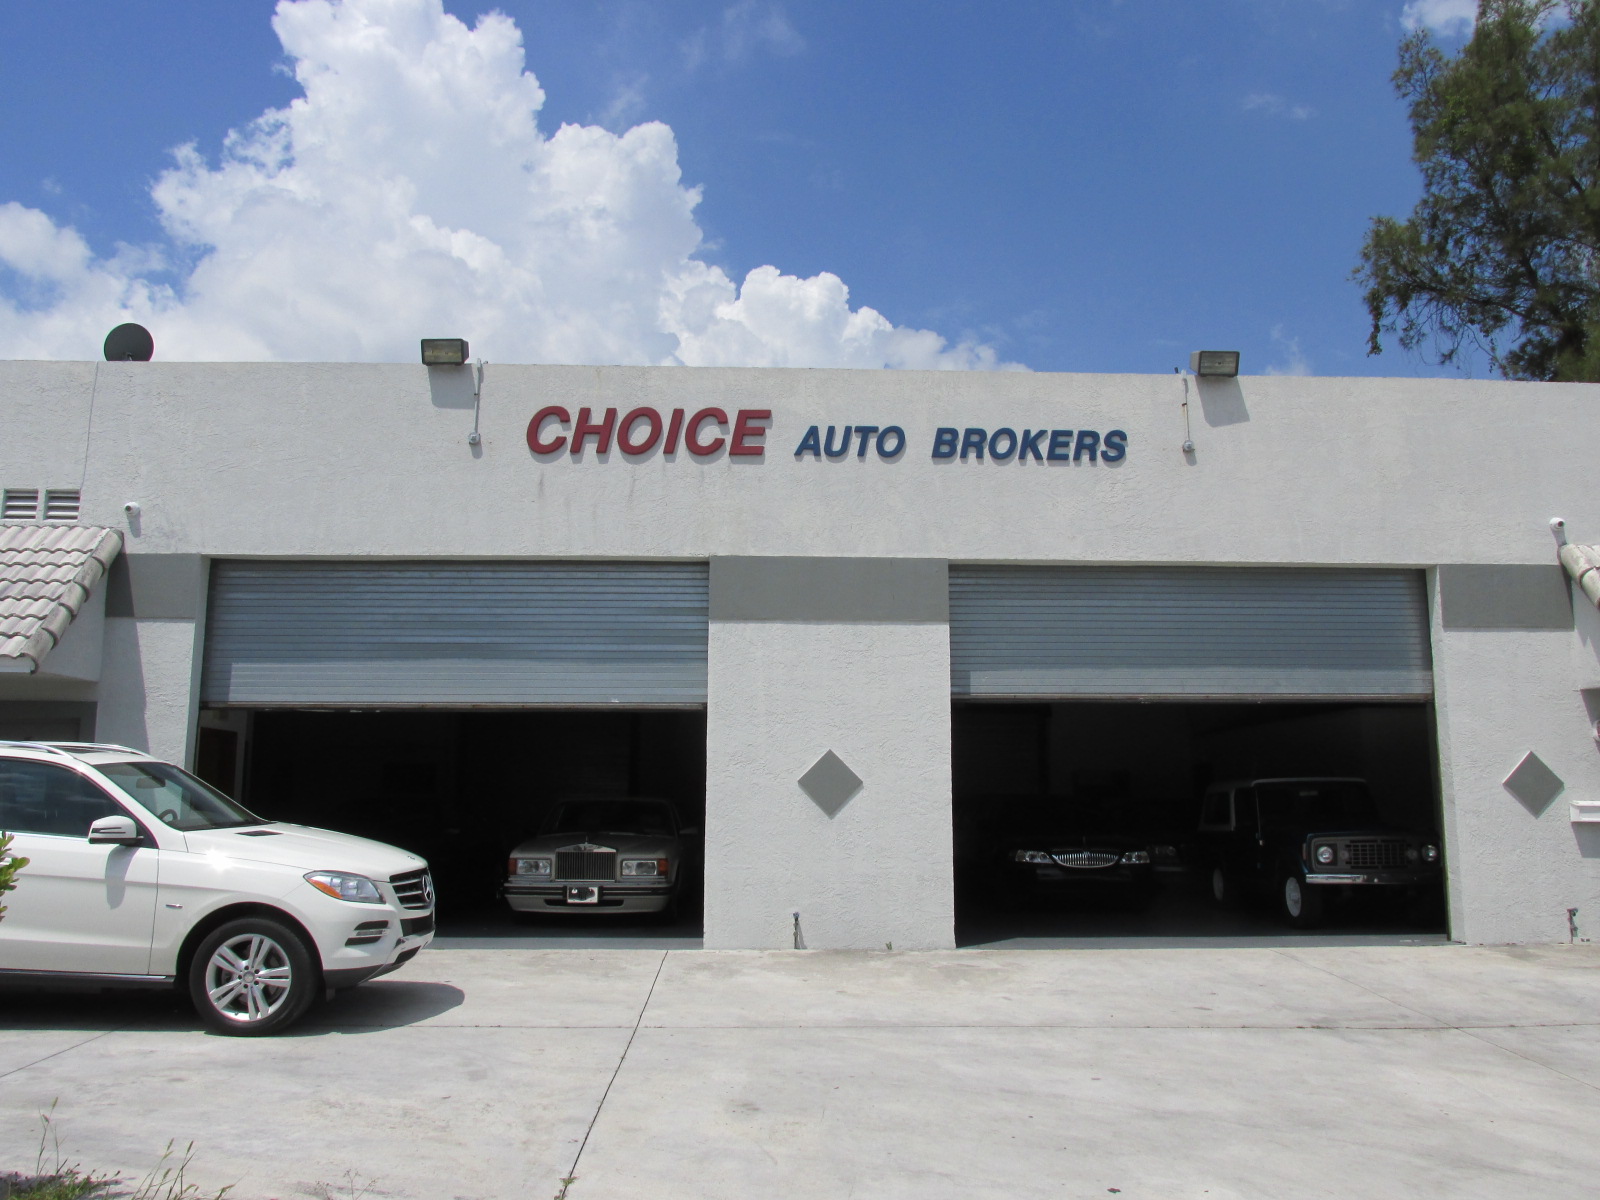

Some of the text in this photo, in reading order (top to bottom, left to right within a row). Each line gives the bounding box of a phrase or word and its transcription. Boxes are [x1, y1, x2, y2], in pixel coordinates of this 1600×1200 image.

[526, 405, 1128, 463] CHOICE AUTO BROKERS
